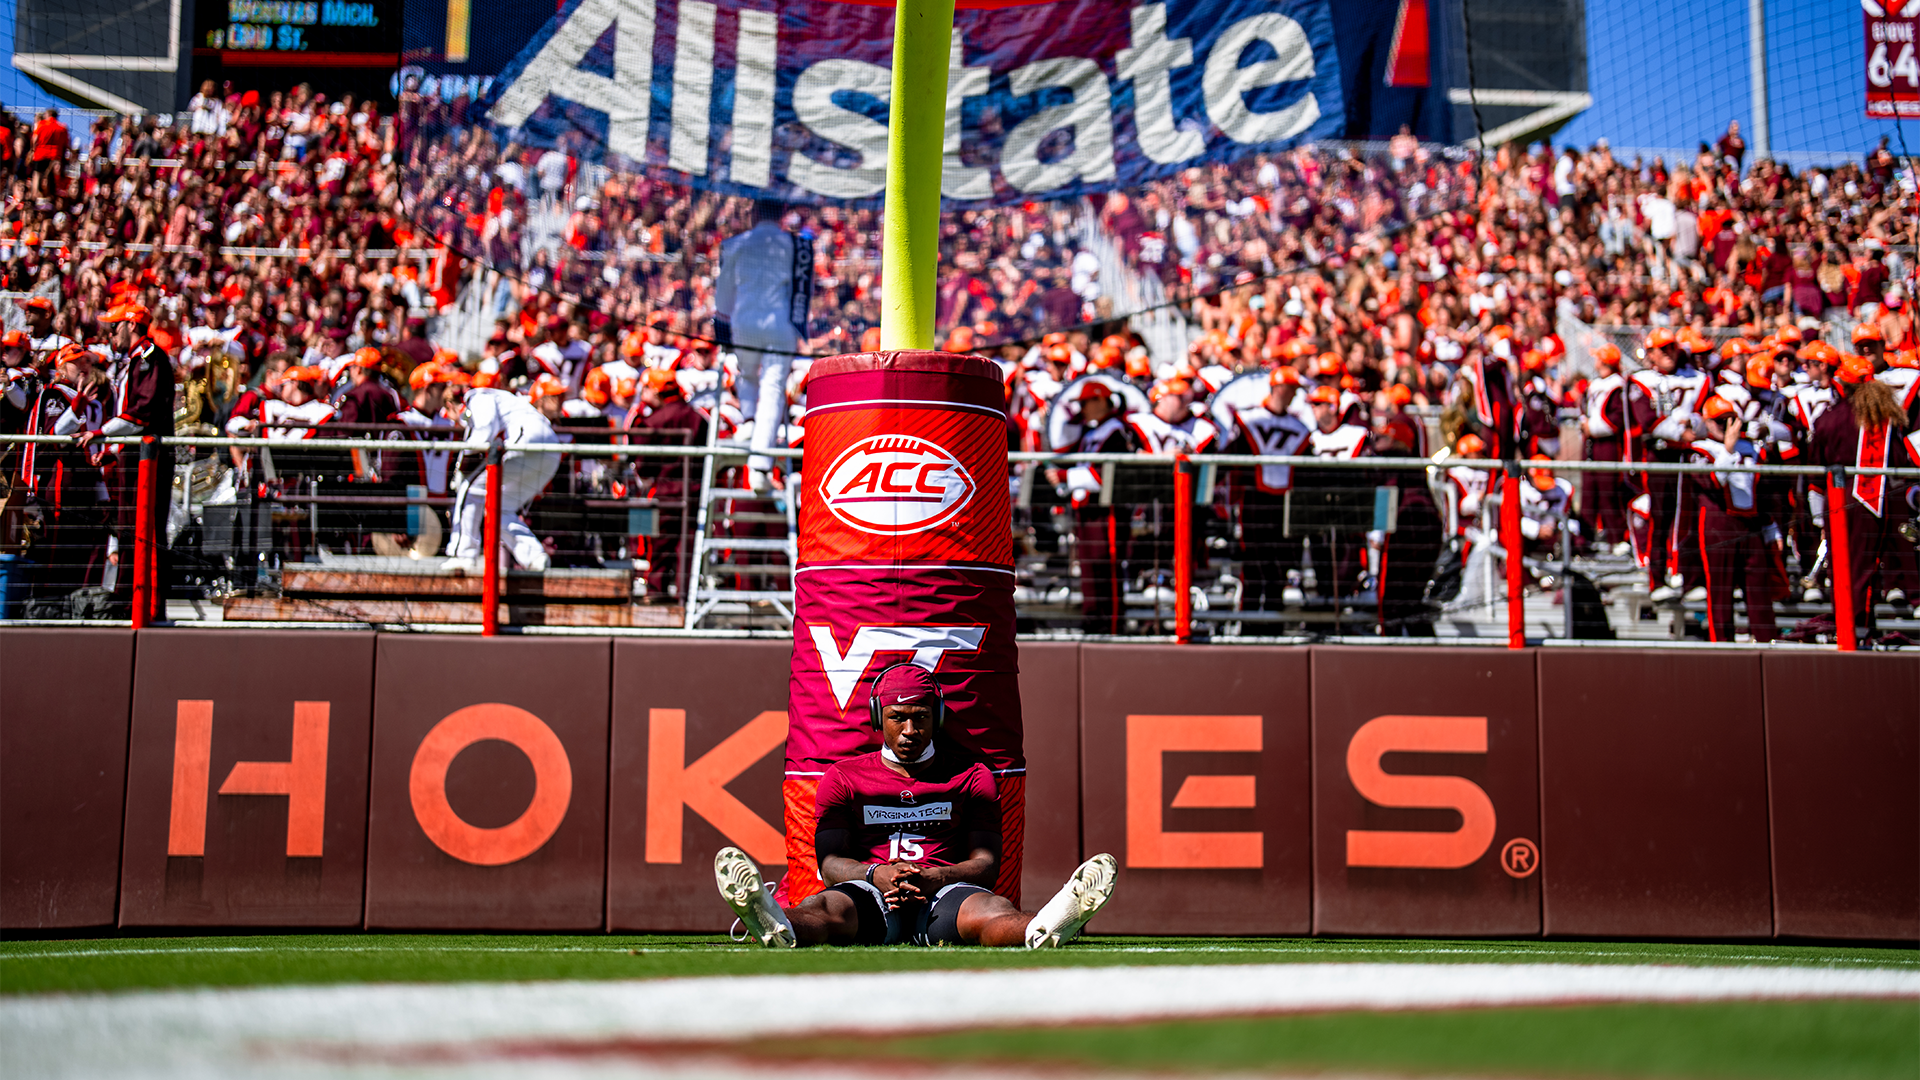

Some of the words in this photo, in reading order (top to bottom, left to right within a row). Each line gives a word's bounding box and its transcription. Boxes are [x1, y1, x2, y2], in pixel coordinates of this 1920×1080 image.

[1868, 42, 1920, 87] 64
[487, 0, 1321, 200] Allstate
[838, 462, 954, 495] ACC
[805, 623, 991, 718] VT
[168, 699, 1497, 869] HOKES
[867, 809, 918, 820] VIRGINIA
[918, 806, 949, 818] TECH
[889, 831, 926, 860] 15
